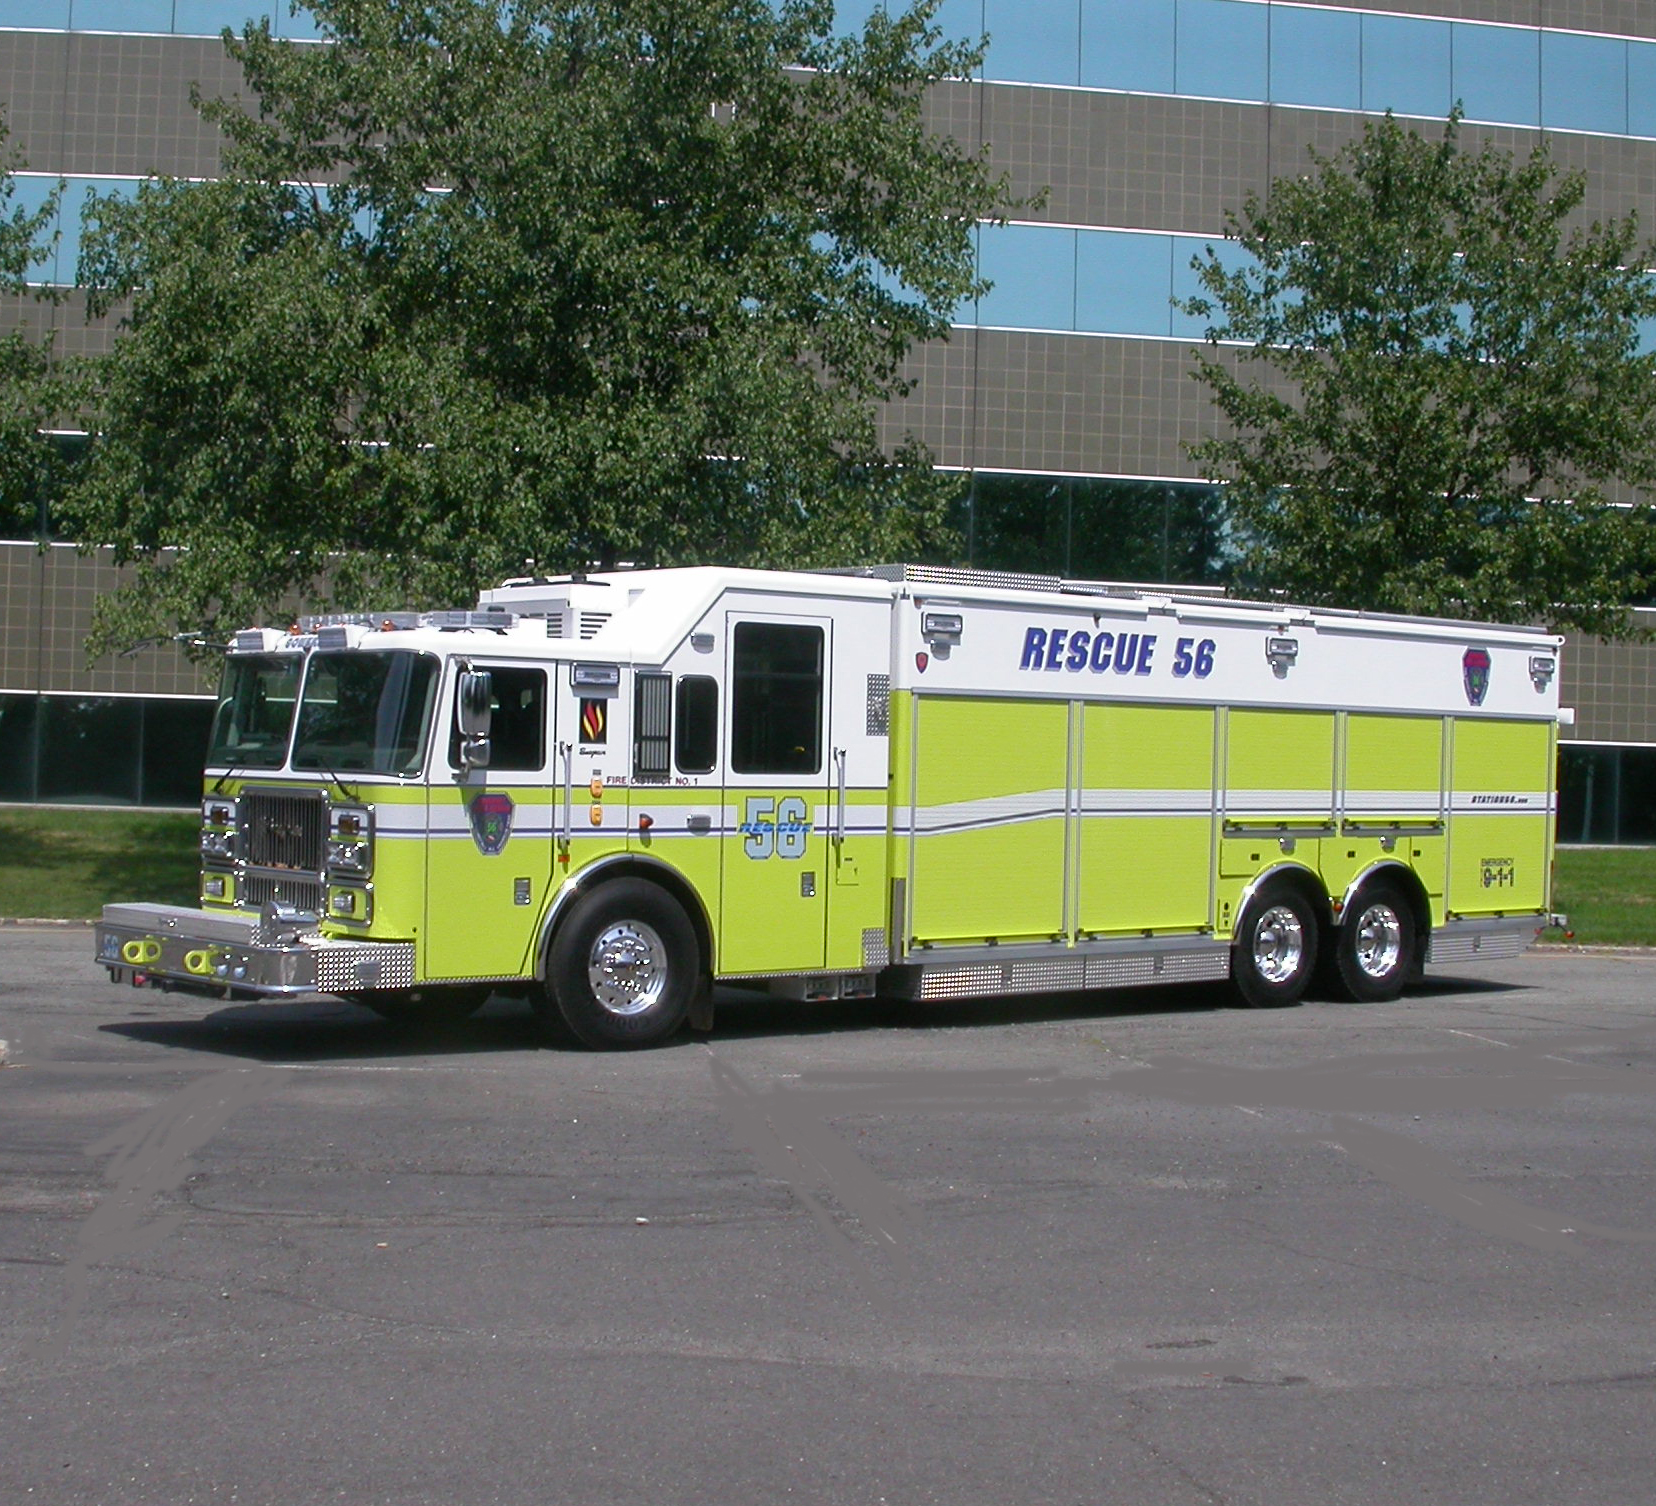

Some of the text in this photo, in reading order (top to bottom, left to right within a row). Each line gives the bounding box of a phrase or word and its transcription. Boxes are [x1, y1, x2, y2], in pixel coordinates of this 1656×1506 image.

[1019, 627, 1217, 680] RESCUE 56
[606, 776, 627, 785] FIRE
[630, 776, 672, 786] DISTRICT
[675, 777, 691, 787] NO.
[739, 822, 813, 833] RESCUE
[744, 796, 807, 860] 56
